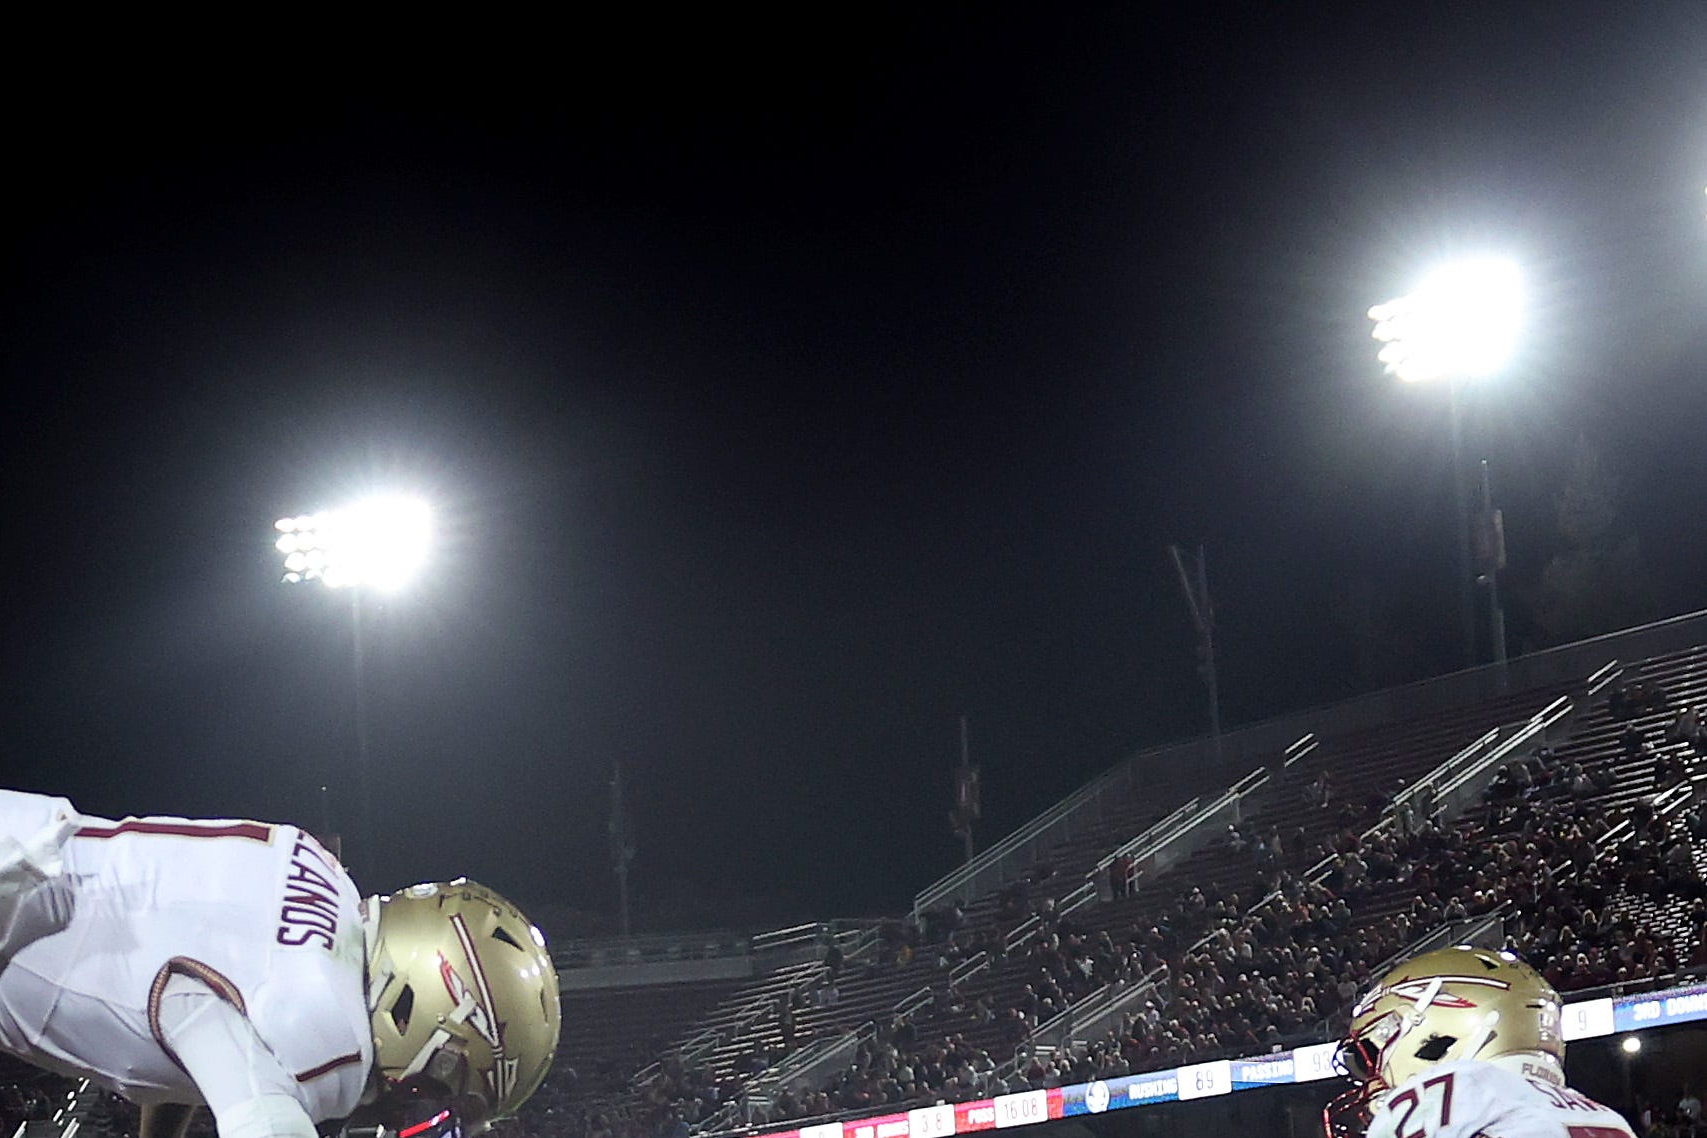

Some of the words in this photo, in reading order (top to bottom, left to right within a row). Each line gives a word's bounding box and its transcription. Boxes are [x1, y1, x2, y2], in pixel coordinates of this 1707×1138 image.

[276, 830, 340, 951] LANOS
[1241, 1059, 1294, 1081] PASSING
[1128, 1078, 1179, 1100] RUSHING
